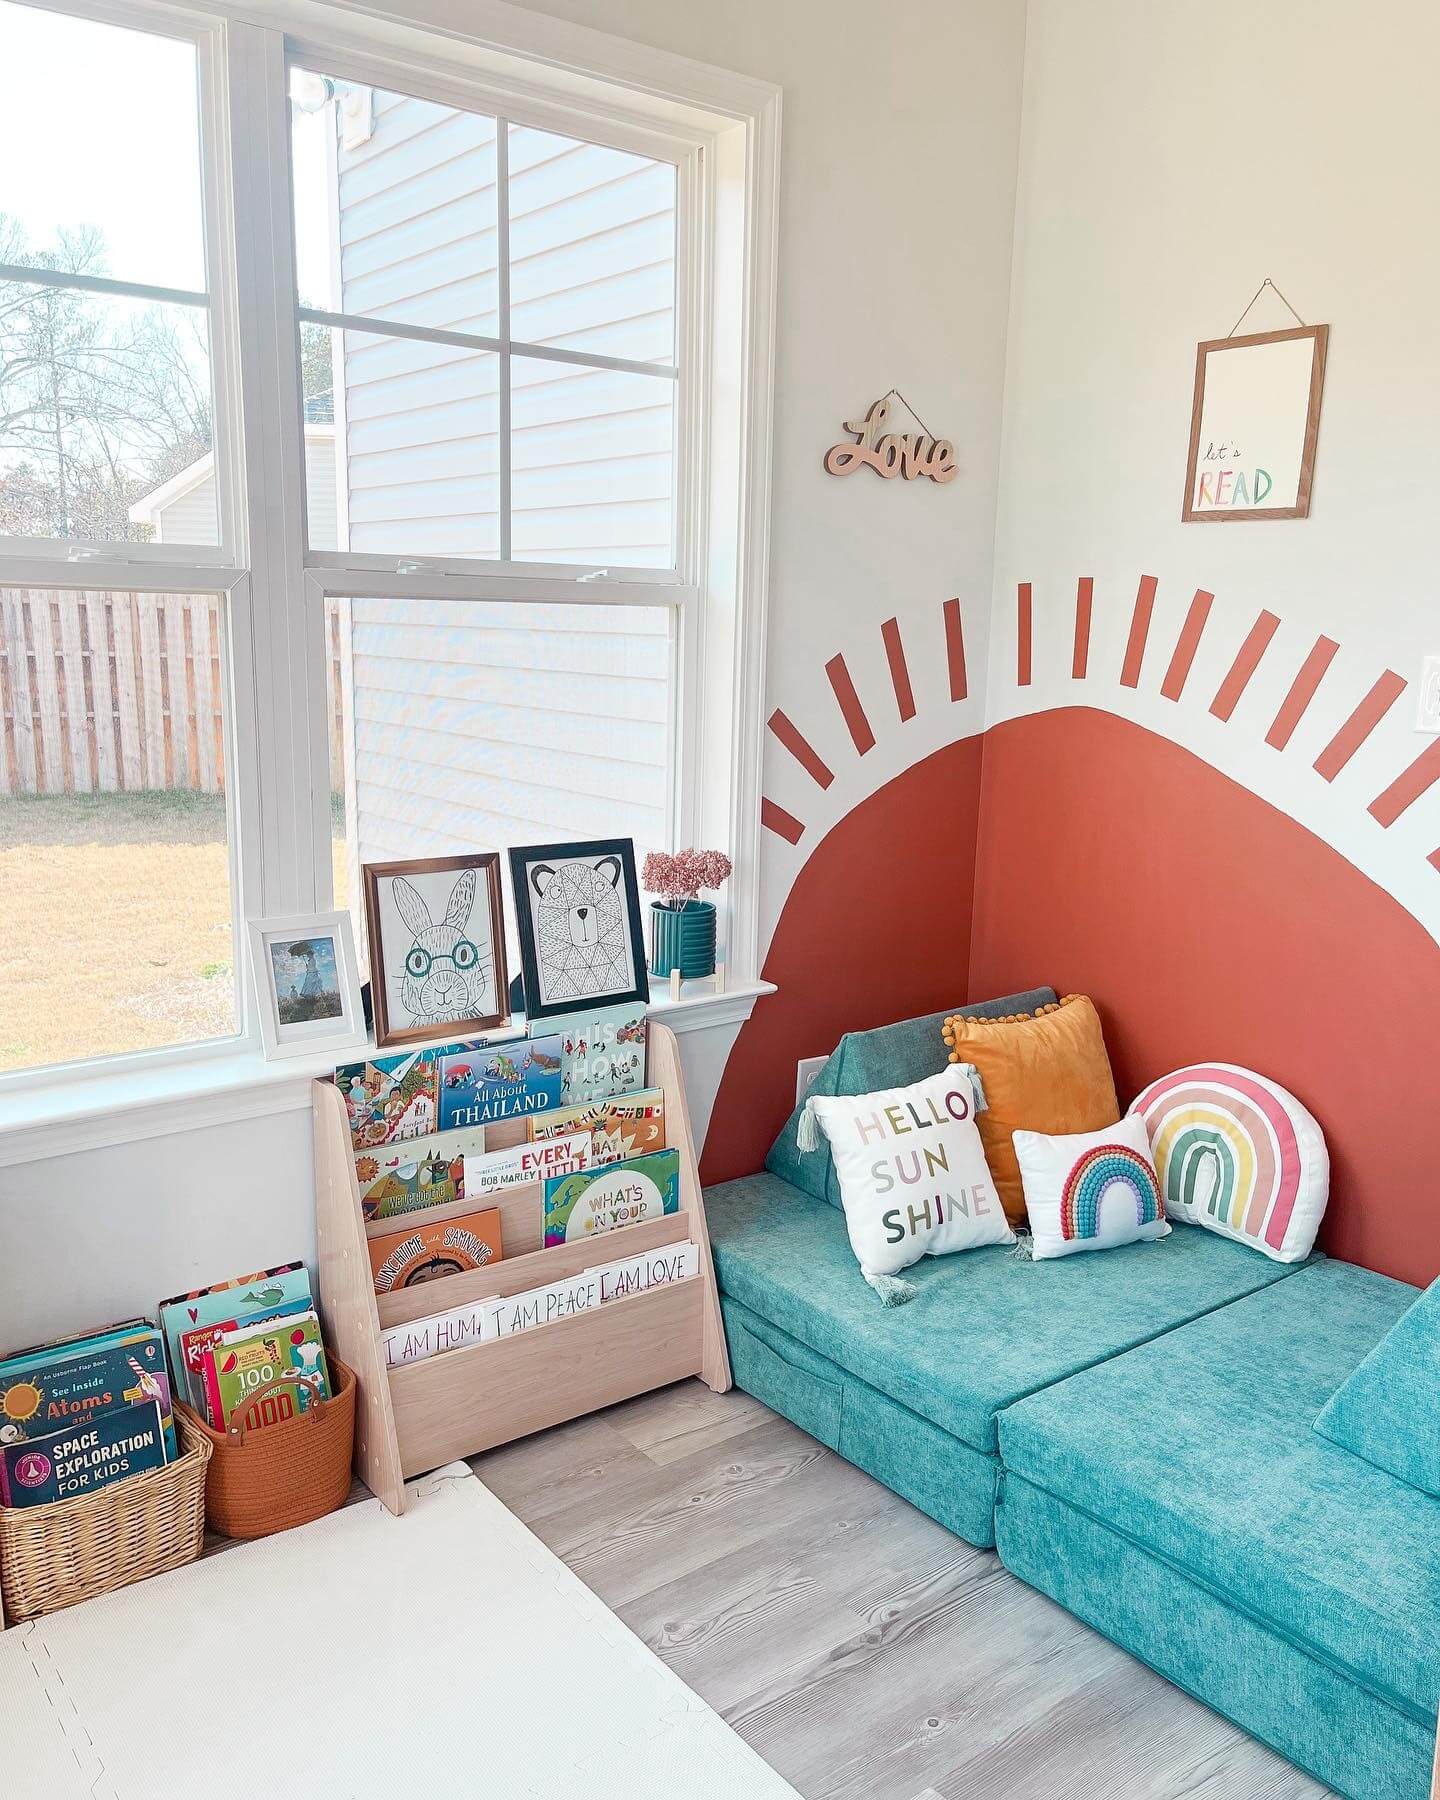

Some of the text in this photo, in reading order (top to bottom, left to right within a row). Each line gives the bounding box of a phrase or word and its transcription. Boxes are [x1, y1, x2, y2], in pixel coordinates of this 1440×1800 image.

[823, 399, 959, 483] Love
[1203, 441, 1241, 461] let's
[1198, 468, 1272, 507] READ
[572, 1050, 634, 1082] HOW
[451, 1092, 549, 1127] THAILAND
[473, 1084, 528, 1104] All About
[854, 1091, 968, 1146] HELLO
[522, 1142, 572, 1171] EVERY
[871, 1143, 950, 1194] SUN
[481, 1170, 537, 1187] BOB MARLEY
[588, 1184, 643, 1213] WHAT'S
[609, 1203, 647, 1223] YOUR
[882, 1184, 991, 1244] SHINE
[374, 1233, 427, 1293] LUNCHTIME
[442, 1226, 493, 1268] SAMNANG
[600, 1254, 686, 1302] I AM LOVE
[511, 1299, 540, 1333] AM
[546, 1283, 595, 1321] PEACE
[189, 1331, 213, 1345] Ranger
[383, 1314, 481, 1365] I AM HUM
[52, 1378, 104, 1398] See Inside
[237, 1365, 274, 1390] 100
[47, 1391, 113, 1420] Atoms
[72, 1413, 93, 1425] and
[230, 1393, 294, 1431] OOD
[53, 1430, 99, 1460] SPACE
[55, 1430, 154, 1480] EXPLORATION
[58, 1473, 90, 1496] FOR
[94, 1459, 130, 1480] KIDS
